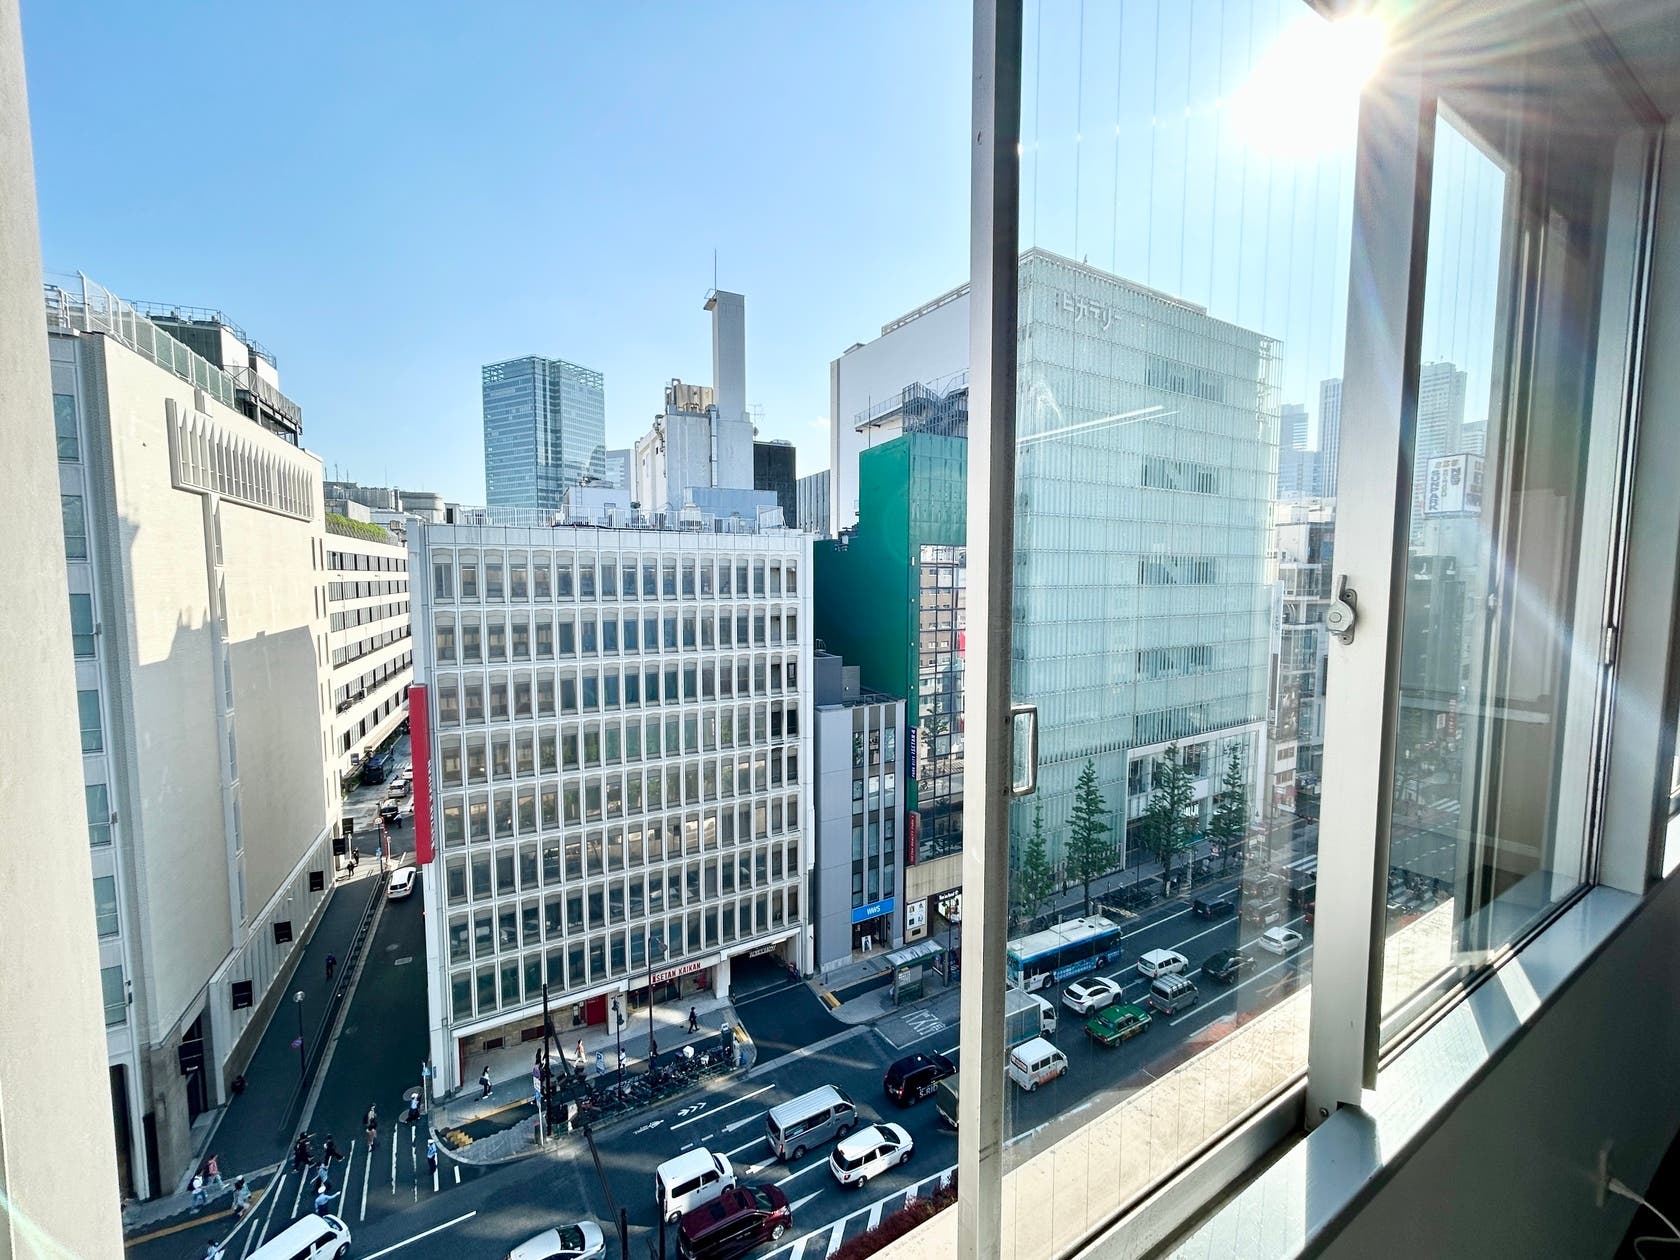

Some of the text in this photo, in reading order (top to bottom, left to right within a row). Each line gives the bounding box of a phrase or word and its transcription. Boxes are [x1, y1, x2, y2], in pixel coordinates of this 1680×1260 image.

[652, 962, 701, 983] ISETAN KAIKAN
[919, 1084, 939, 1099] S.RID
